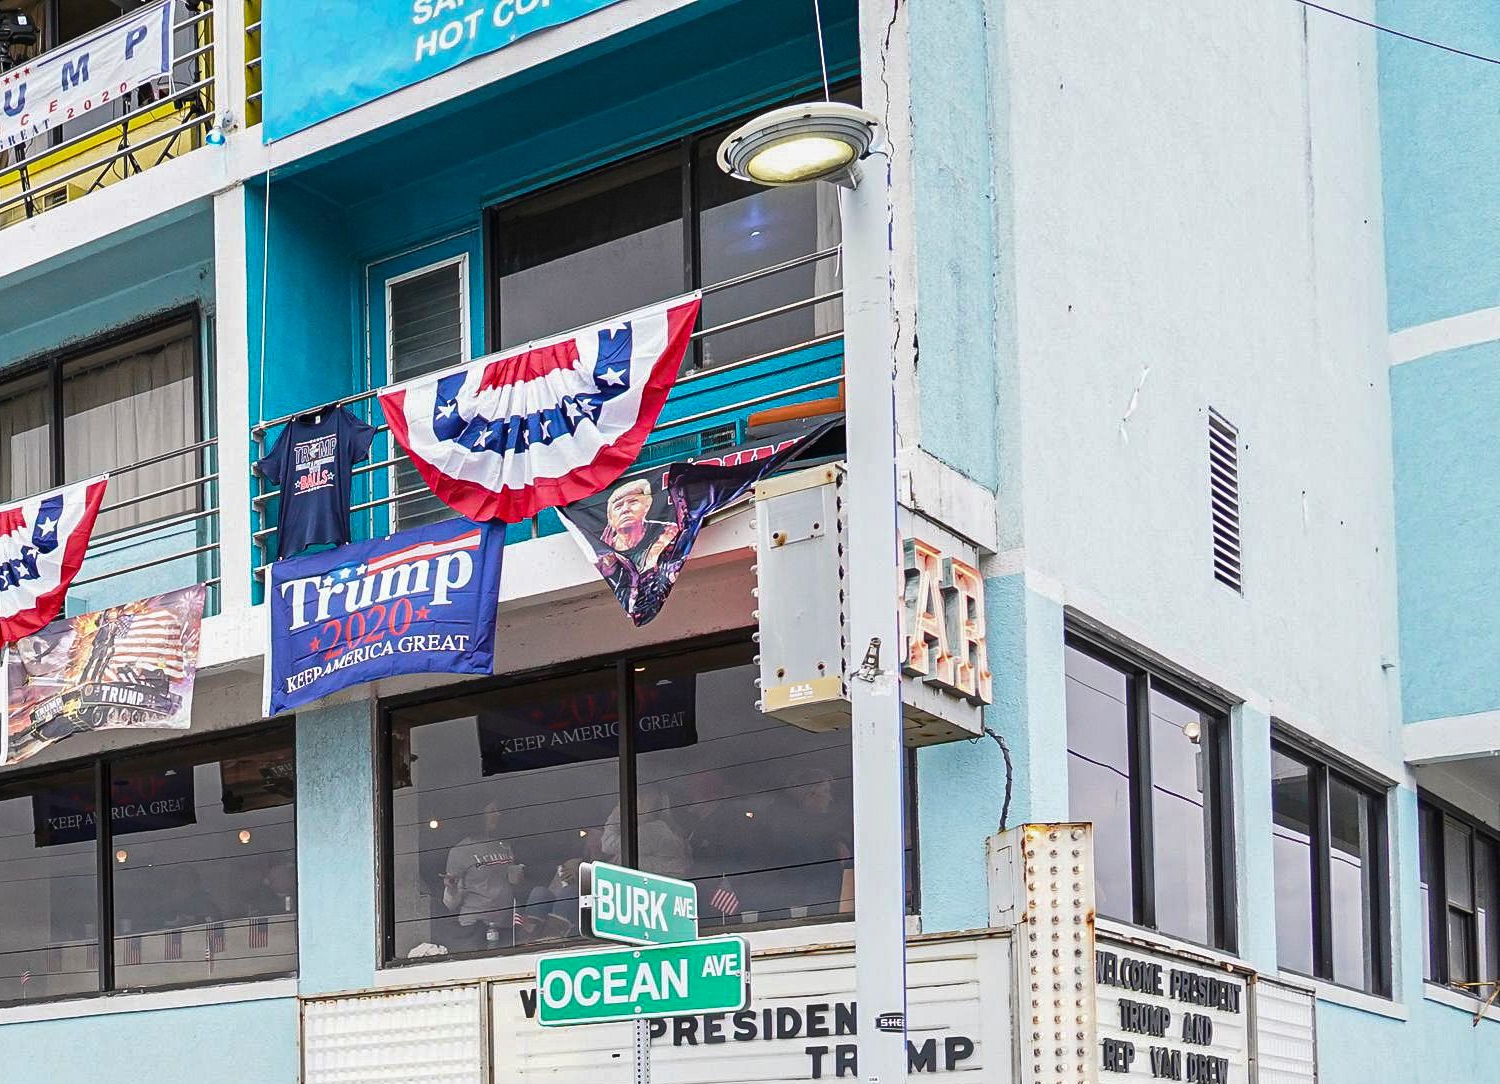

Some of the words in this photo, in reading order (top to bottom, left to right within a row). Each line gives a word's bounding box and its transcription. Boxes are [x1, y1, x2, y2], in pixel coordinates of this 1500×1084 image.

[414, 9, 484, 62] HOT
[66, 81, 128, 119] 2020
[300, 469, 329, 490] BALLS
[281, 550, 473, 632] Trump
[322, 598, 413, 661] 2020
[900, 537, 993, 706] AR
[286, 667, 322, 694] KEEP
[322, 642, 394, 675] AMERICA
[397, 634, 469, 653] GREAT
[101, 685, 144, 706] TRUMP
[500, 734, 546, 754] KEEP
[549, 721, 620, 746] AMERIC
[639, 711, 686, 732] GREAT
[271, 763, 293, 777] TRU
[49, 813, 82, 830] KEEP
[150, 796, 185, 814] GREAT
[597, 879, 669, 932] BURK
[673, 896, 694, 918] AVE
[543, 958, 689, 1009] OCEAN
[701, 954, 738, 978] AVE
[1095, 951, 1164, 996] WELCOME
[1170, 969, 1242, 1014] PRESIDENT
[649, 1002, 858, 1046] PRESIDEN
[1119, 998, 1171, 1038] TRUMP
[1182, 1012, 1213, 1046] AND
[805, 1036, 975, 1079] TRMP
[1103, 1038, 1136, 1073] REP
[1150, 1046, 1182, 1081] VAN
